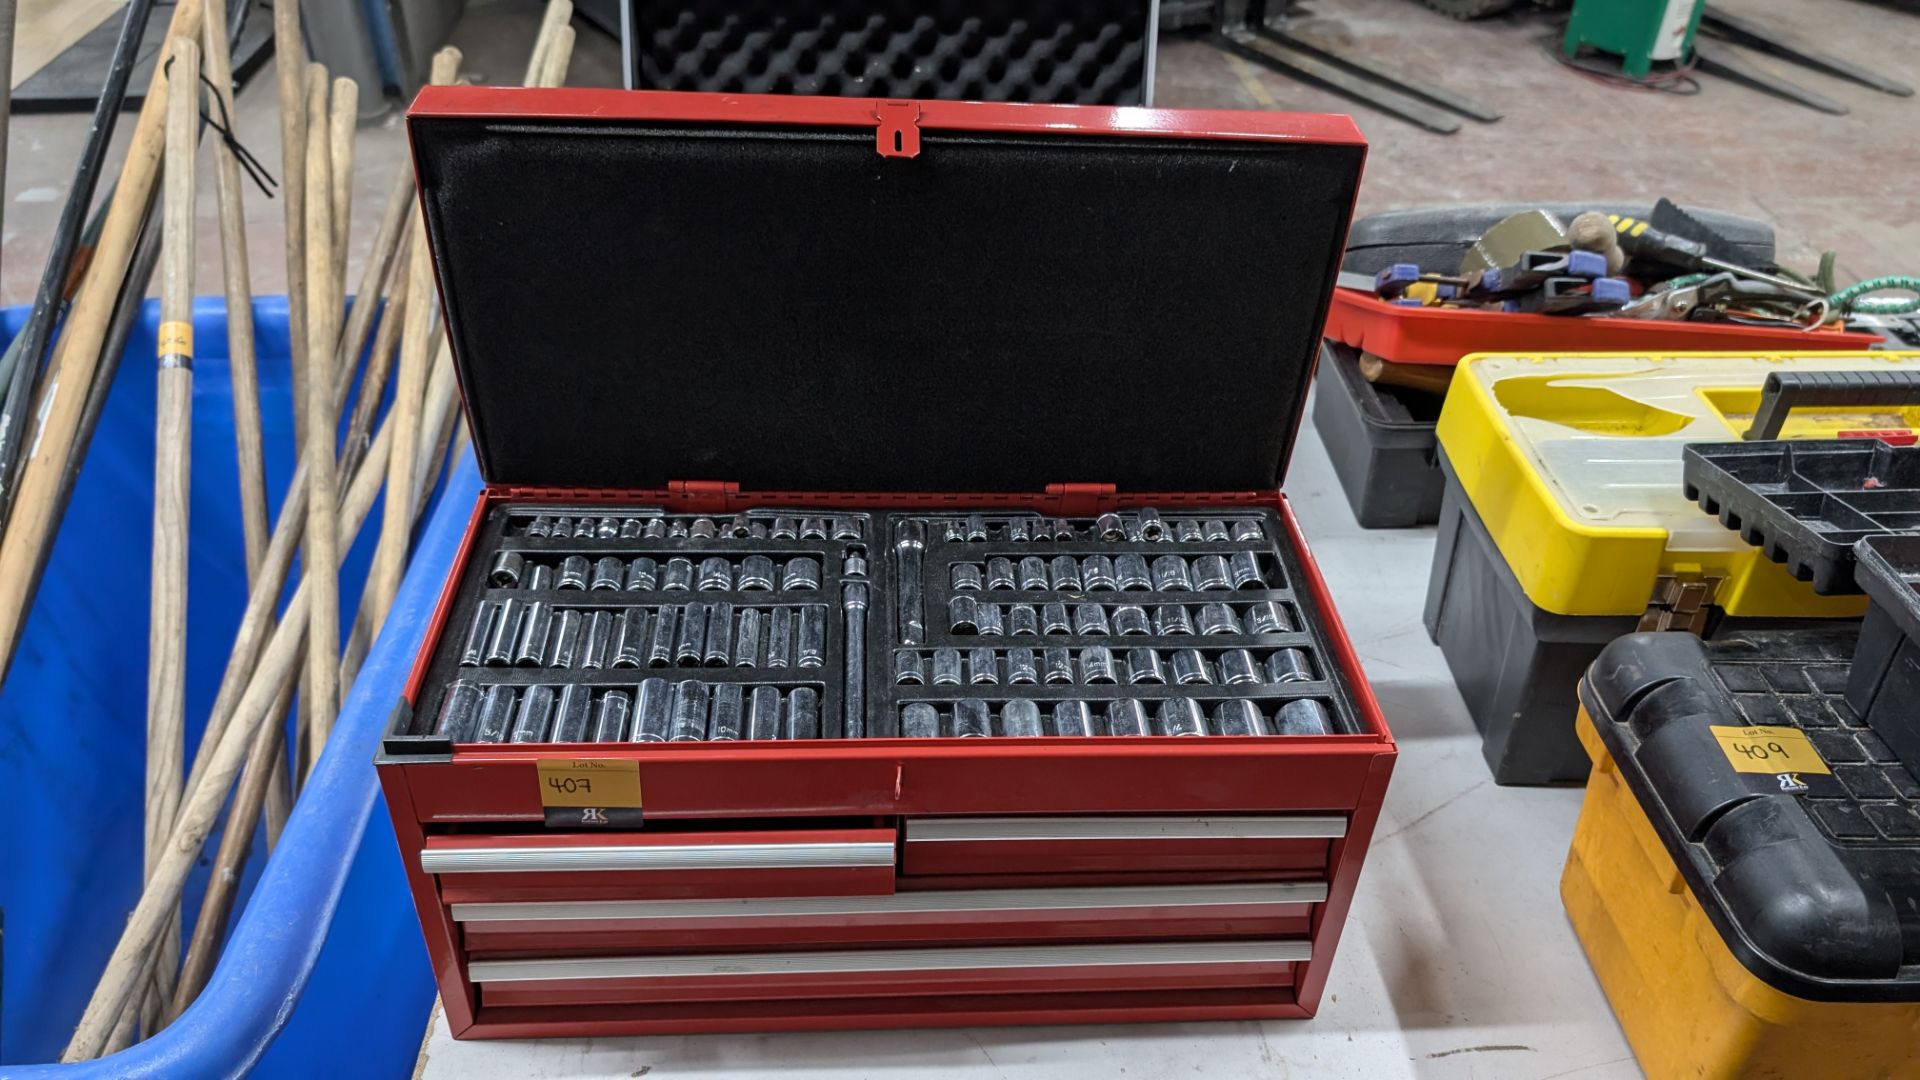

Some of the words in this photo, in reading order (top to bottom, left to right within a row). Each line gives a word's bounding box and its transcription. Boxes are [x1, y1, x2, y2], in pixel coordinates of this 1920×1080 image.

[1733, 742, 1790, 760] 409
[572, 761, 587, 769] Lot
[590, 761, 606, 769] No.
[548, 776, 591, 793] 407
